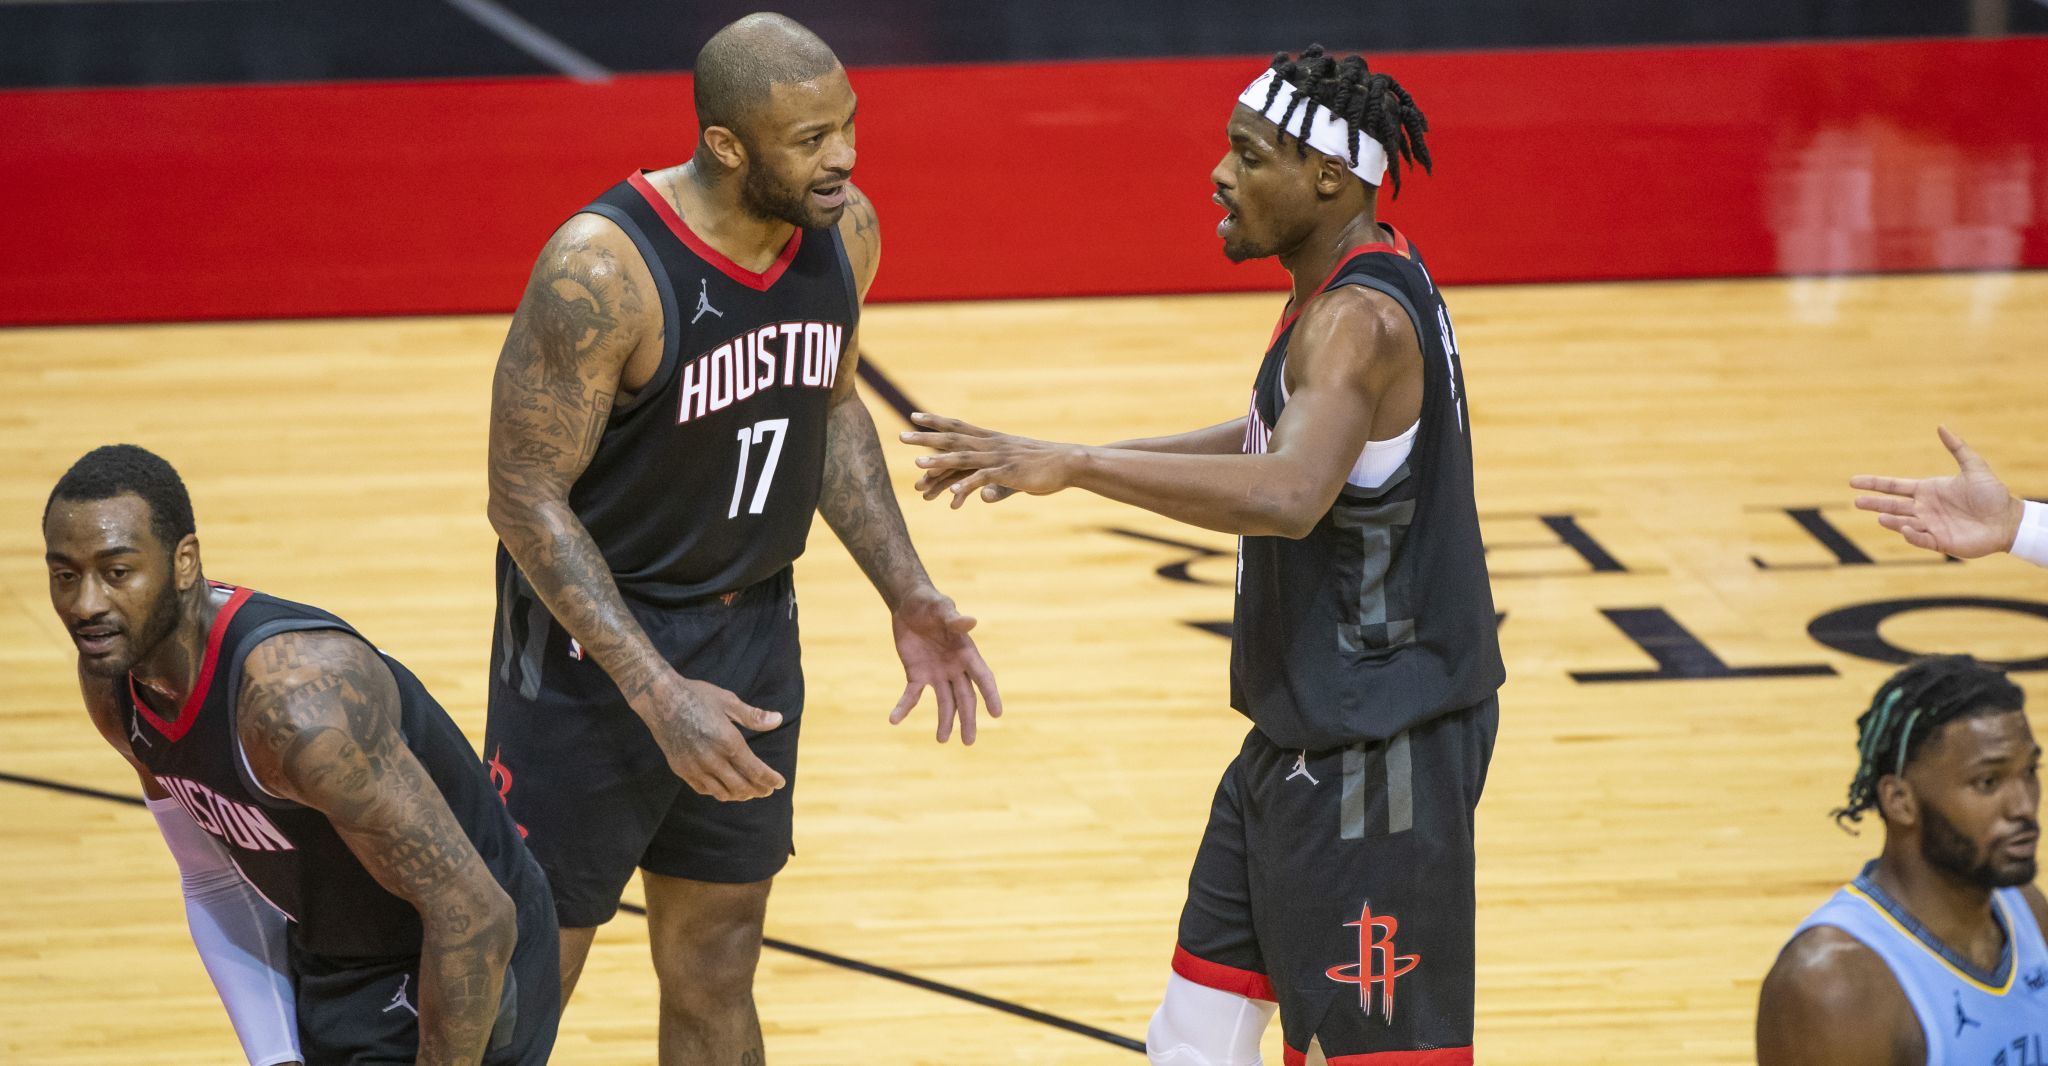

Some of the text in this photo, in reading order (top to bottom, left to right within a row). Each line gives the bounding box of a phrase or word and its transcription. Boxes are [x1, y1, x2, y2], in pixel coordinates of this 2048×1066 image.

[677, 320, 843, 425] HOUSTON
[728, 418, 789, 519] 17
[154, 775, 296, 851] USTON
